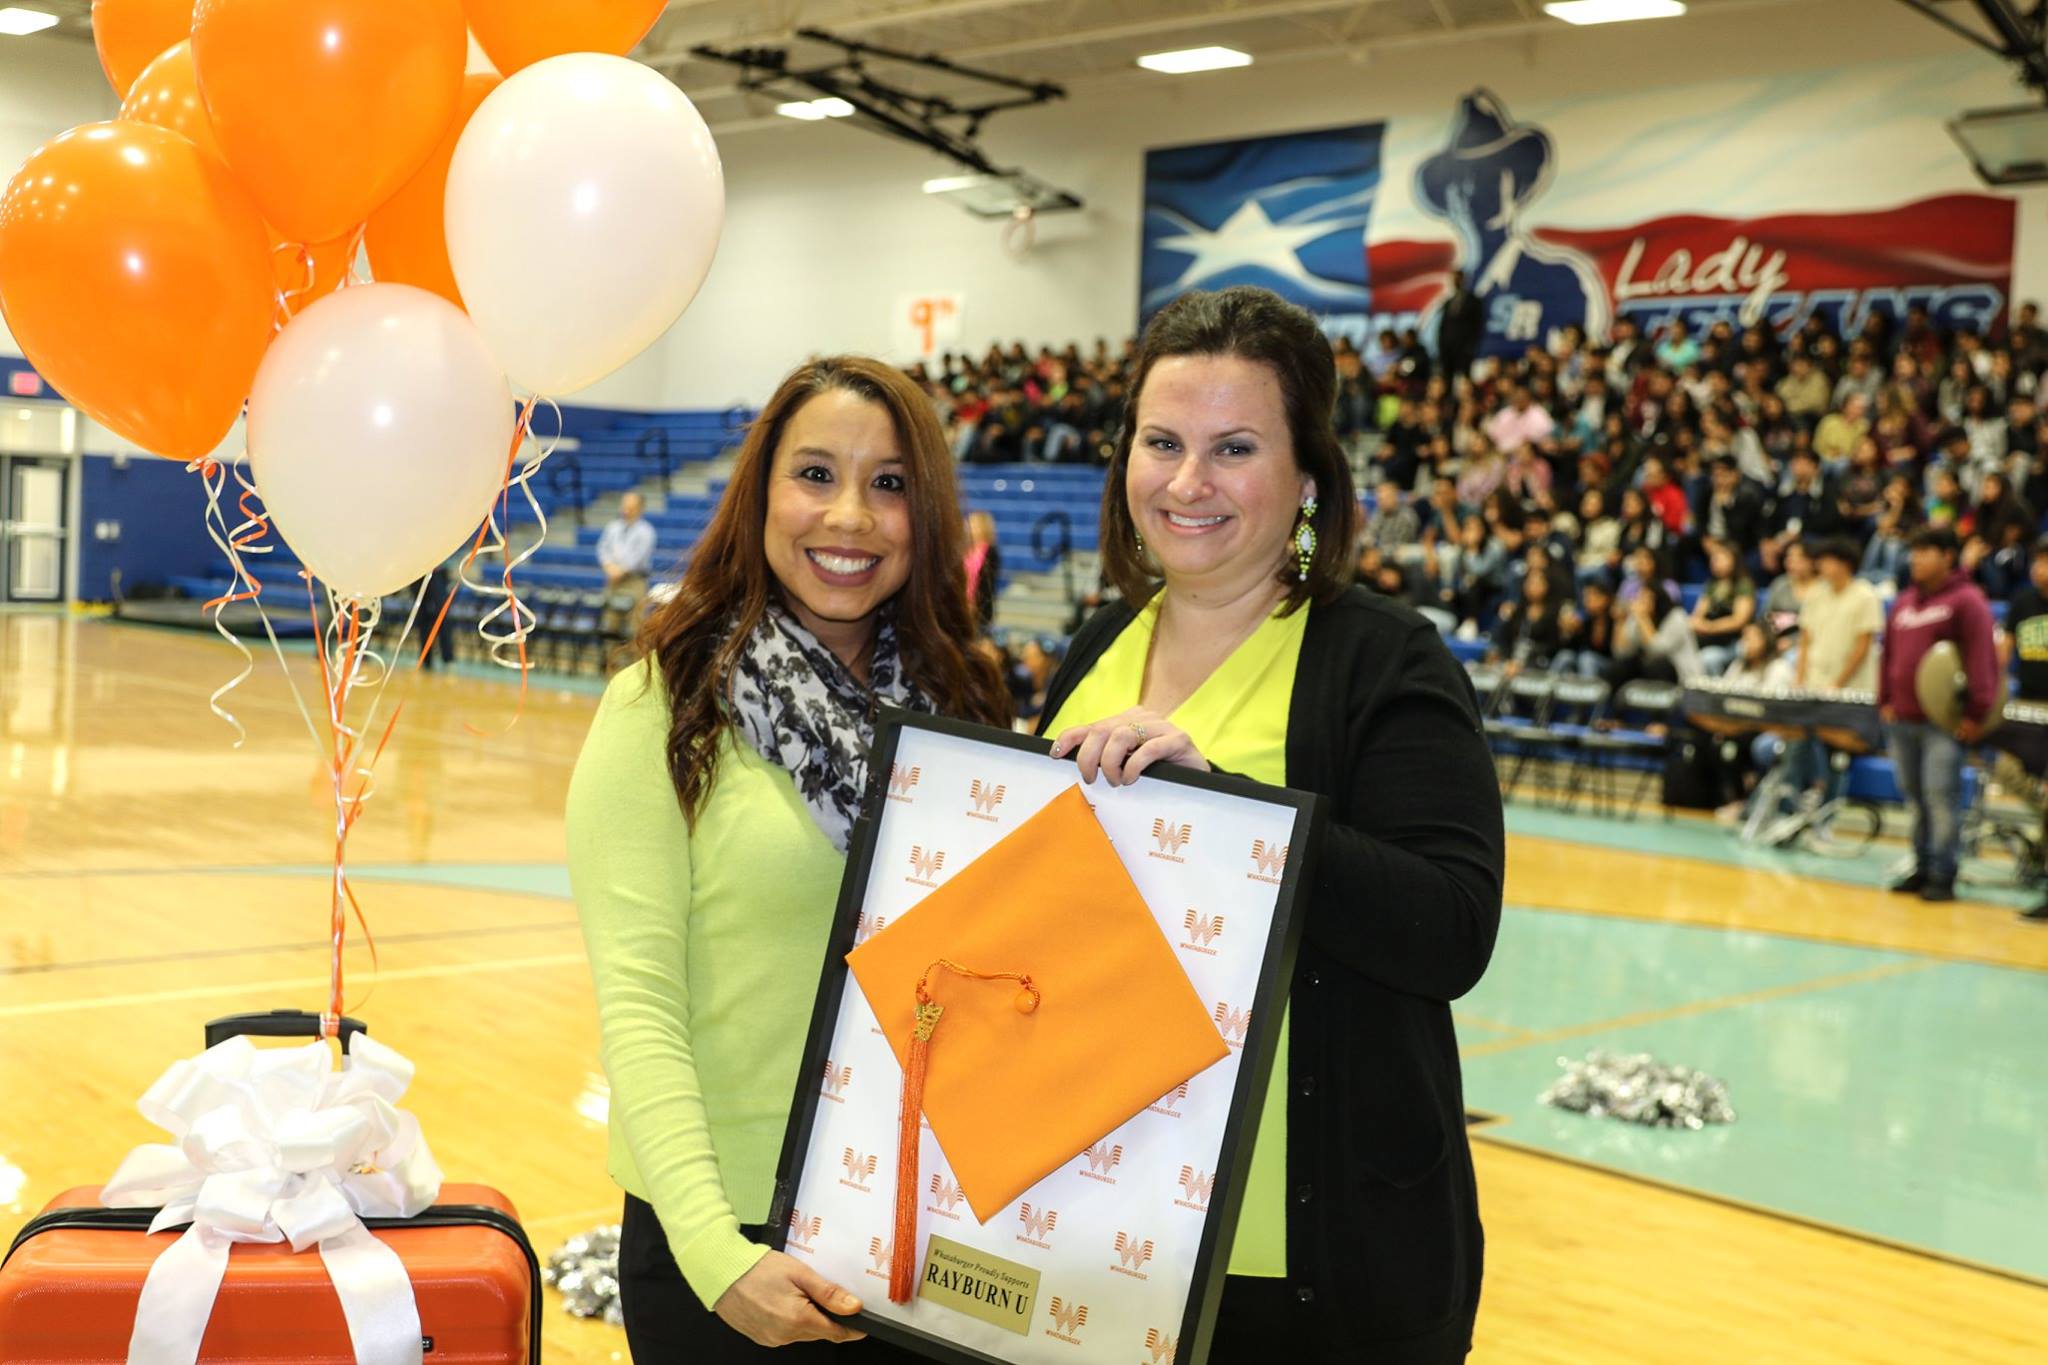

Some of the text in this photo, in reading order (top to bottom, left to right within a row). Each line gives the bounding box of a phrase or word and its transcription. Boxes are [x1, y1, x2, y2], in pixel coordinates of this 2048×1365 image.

[1614, 236, 1790, 327] Lady
[926, 1262, 1029, 1315] RAYBURN U
[934, 1247, 1030, 1290] Whataburger Proudly Supports
